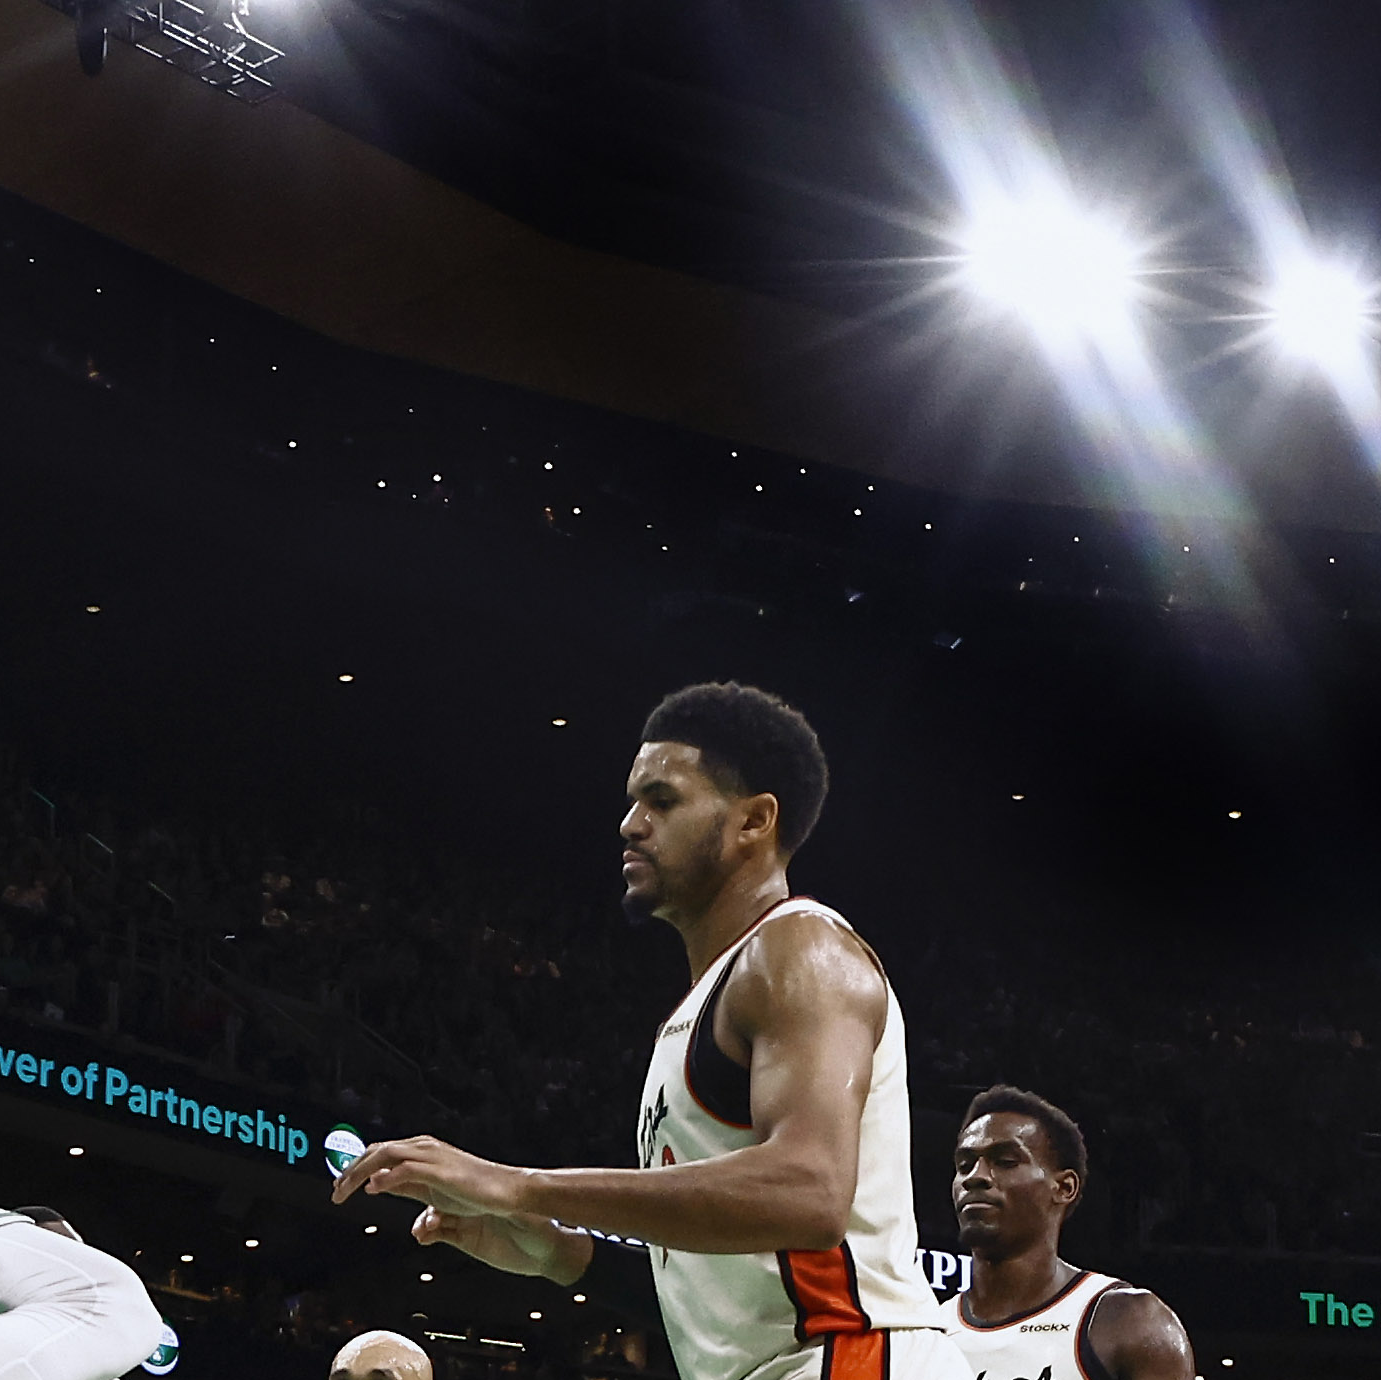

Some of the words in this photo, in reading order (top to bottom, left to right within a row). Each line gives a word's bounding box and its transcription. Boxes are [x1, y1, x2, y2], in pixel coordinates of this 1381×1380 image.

[61, 1061, 99, 1100] of
[105, 1067, 309, 1164] Partnership
[1300, 1291, 1374, 1328] The
